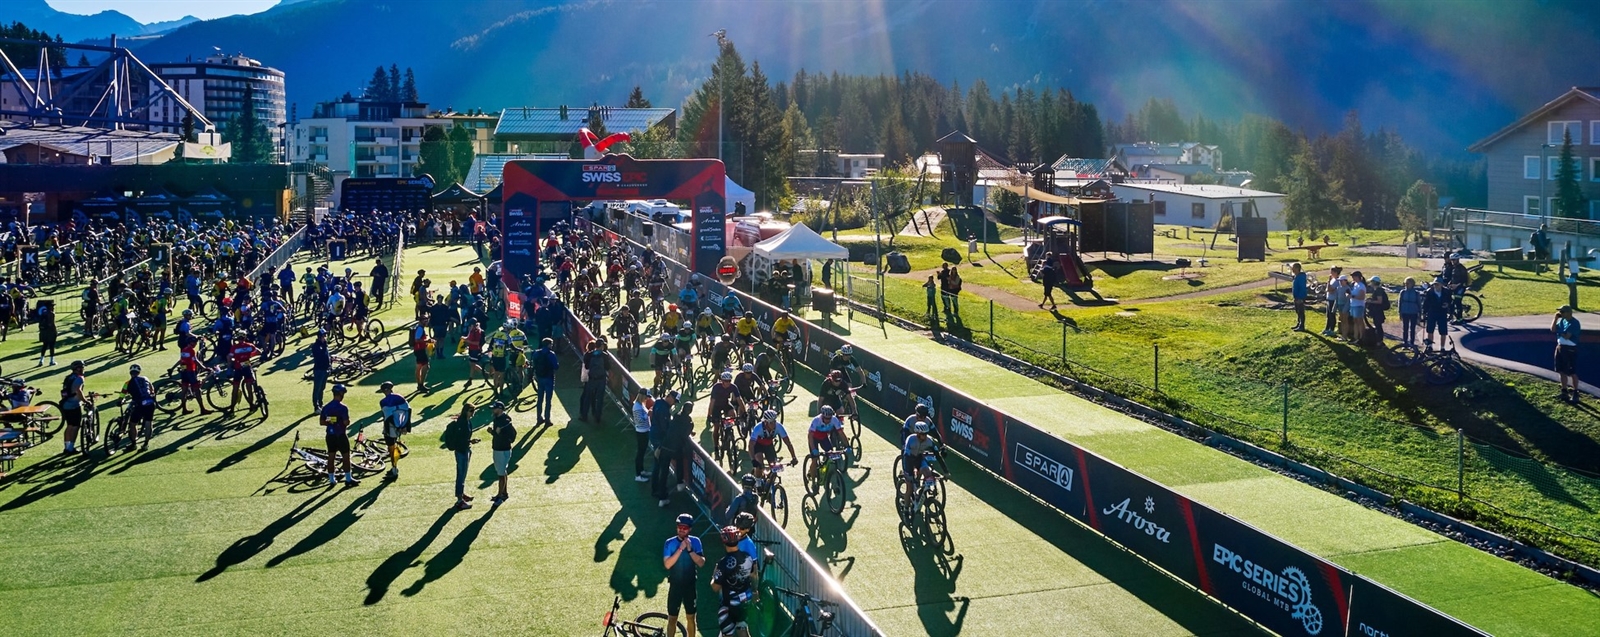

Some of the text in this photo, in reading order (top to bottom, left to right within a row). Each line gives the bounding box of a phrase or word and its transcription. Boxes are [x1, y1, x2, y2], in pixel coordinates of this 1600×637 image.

[582, 172, 622, 182] SWISS
[26, 252, 36, 263] K
[155, 250, 163, 261] J
[950, 418, 974, 441] SWISS
[1024, 452, 1058, 480] SPAR
[1102, 497, 1172, 544] Arosa
[1212, 543, 1300, 603] EPIC SERIES
[1241, 580, 1290, 612] GLOBAL MTB
